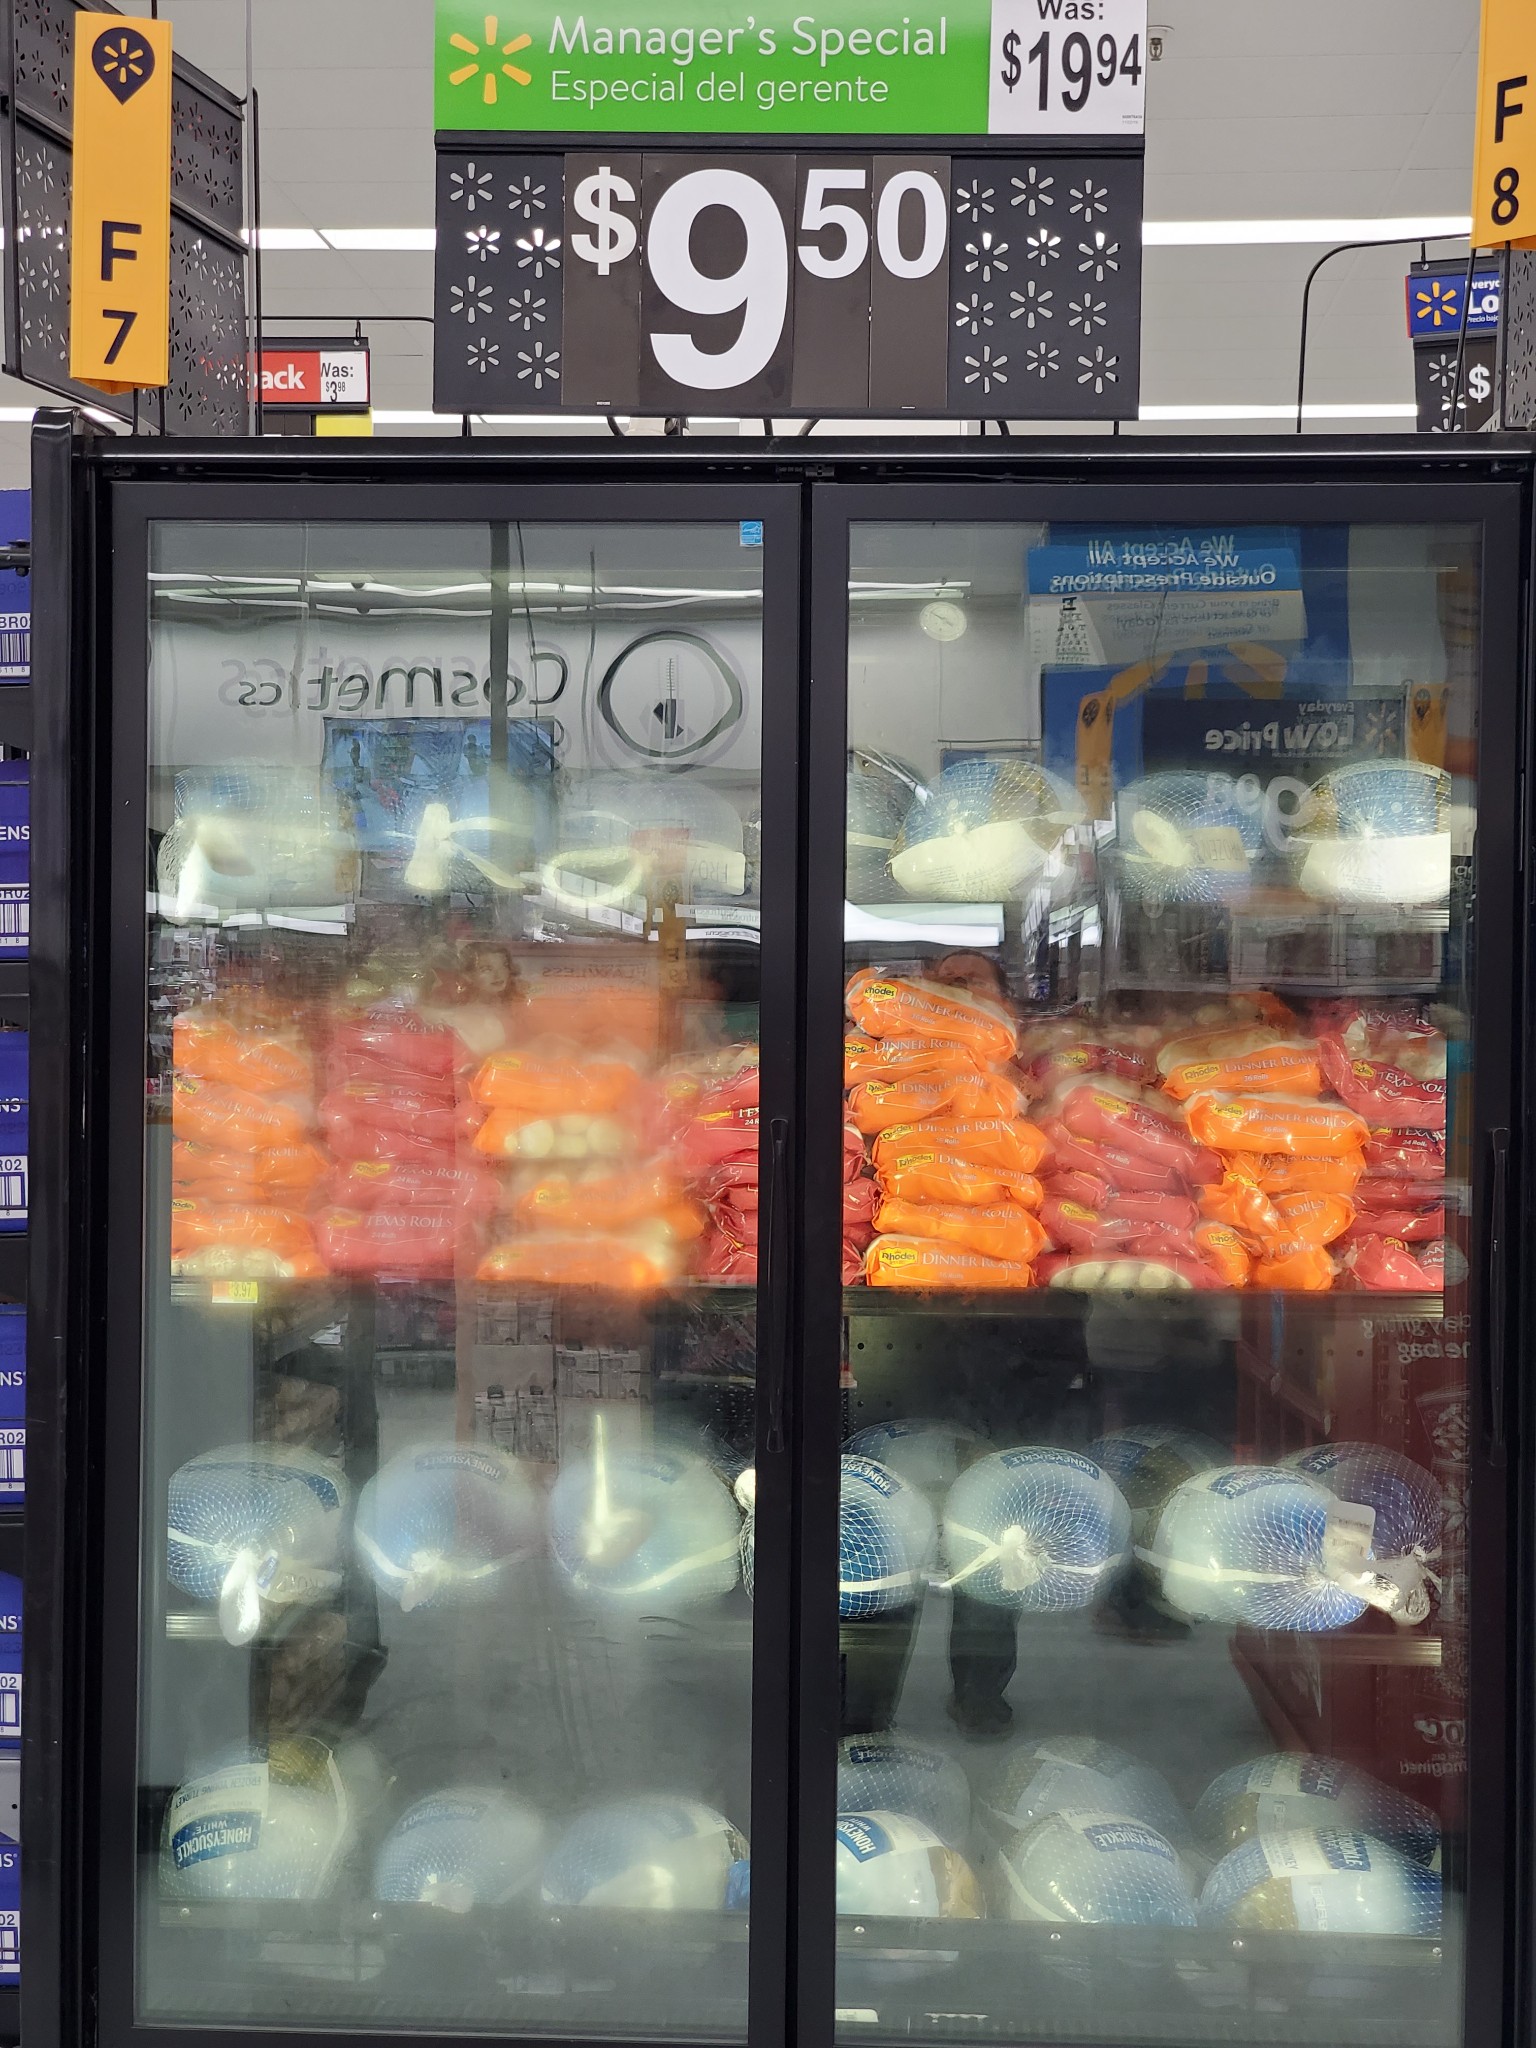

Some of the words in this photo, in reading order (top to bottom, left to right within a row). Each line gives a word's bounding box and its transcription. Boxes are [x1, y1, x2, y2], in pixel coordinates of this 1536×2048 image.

[1037, 0, 1104, 21] Was:
[548, 15, 778, 67] Manager's
[792, 15, 947, 67] Special
[551, 71, 685, 110] Especial
[696, 71, 744, 102] del
[756, 75, 890, 110] gerente
[1494, 75, 1528, 144] F
[1491, 167, 1520, 226] 8
[101, 220, 143, 282] F
[1465, 279, 1500, 291] very
[102, 309, 138, 365] 7
[321, 362, 354, 378] Was:
[1468, 363, 1491, 404] $
[900, 991, 951, 1017] DINNER
[953, 1010, 995, 1031] ROLLS
[1184, 1064, 1220, 1080] Rhodes
[1224, 1058, 1277, 1073] DINNER
[1213, 1103, 1244, 1116] hodes
[1247, 1110, 1301, 1122] DINNER
[1305, 1114, 1348, 1129] ROLLS
[267, 1147, 301, 1158] ROLL
[366, 1215, 406, 1228] TEXAS
[409, 1215, 453, 1228] ROLLS
[881, 1251, 916, 1262] Rhodes
[922, 1252, 978, 1268] DINNER
[980, 1255, 1022, 1270] ROLLS
[0, 1371, 23, 1386] NS
[1011, 1450, 1096, 1475] HONEYSUCKLE
[195, 1819, 228, 1835] WHITE
[177, 1826, 252, 1862] HONEYSUCKLE
[1094, 1830, 1171, 1856] HONEYSUCKLE
